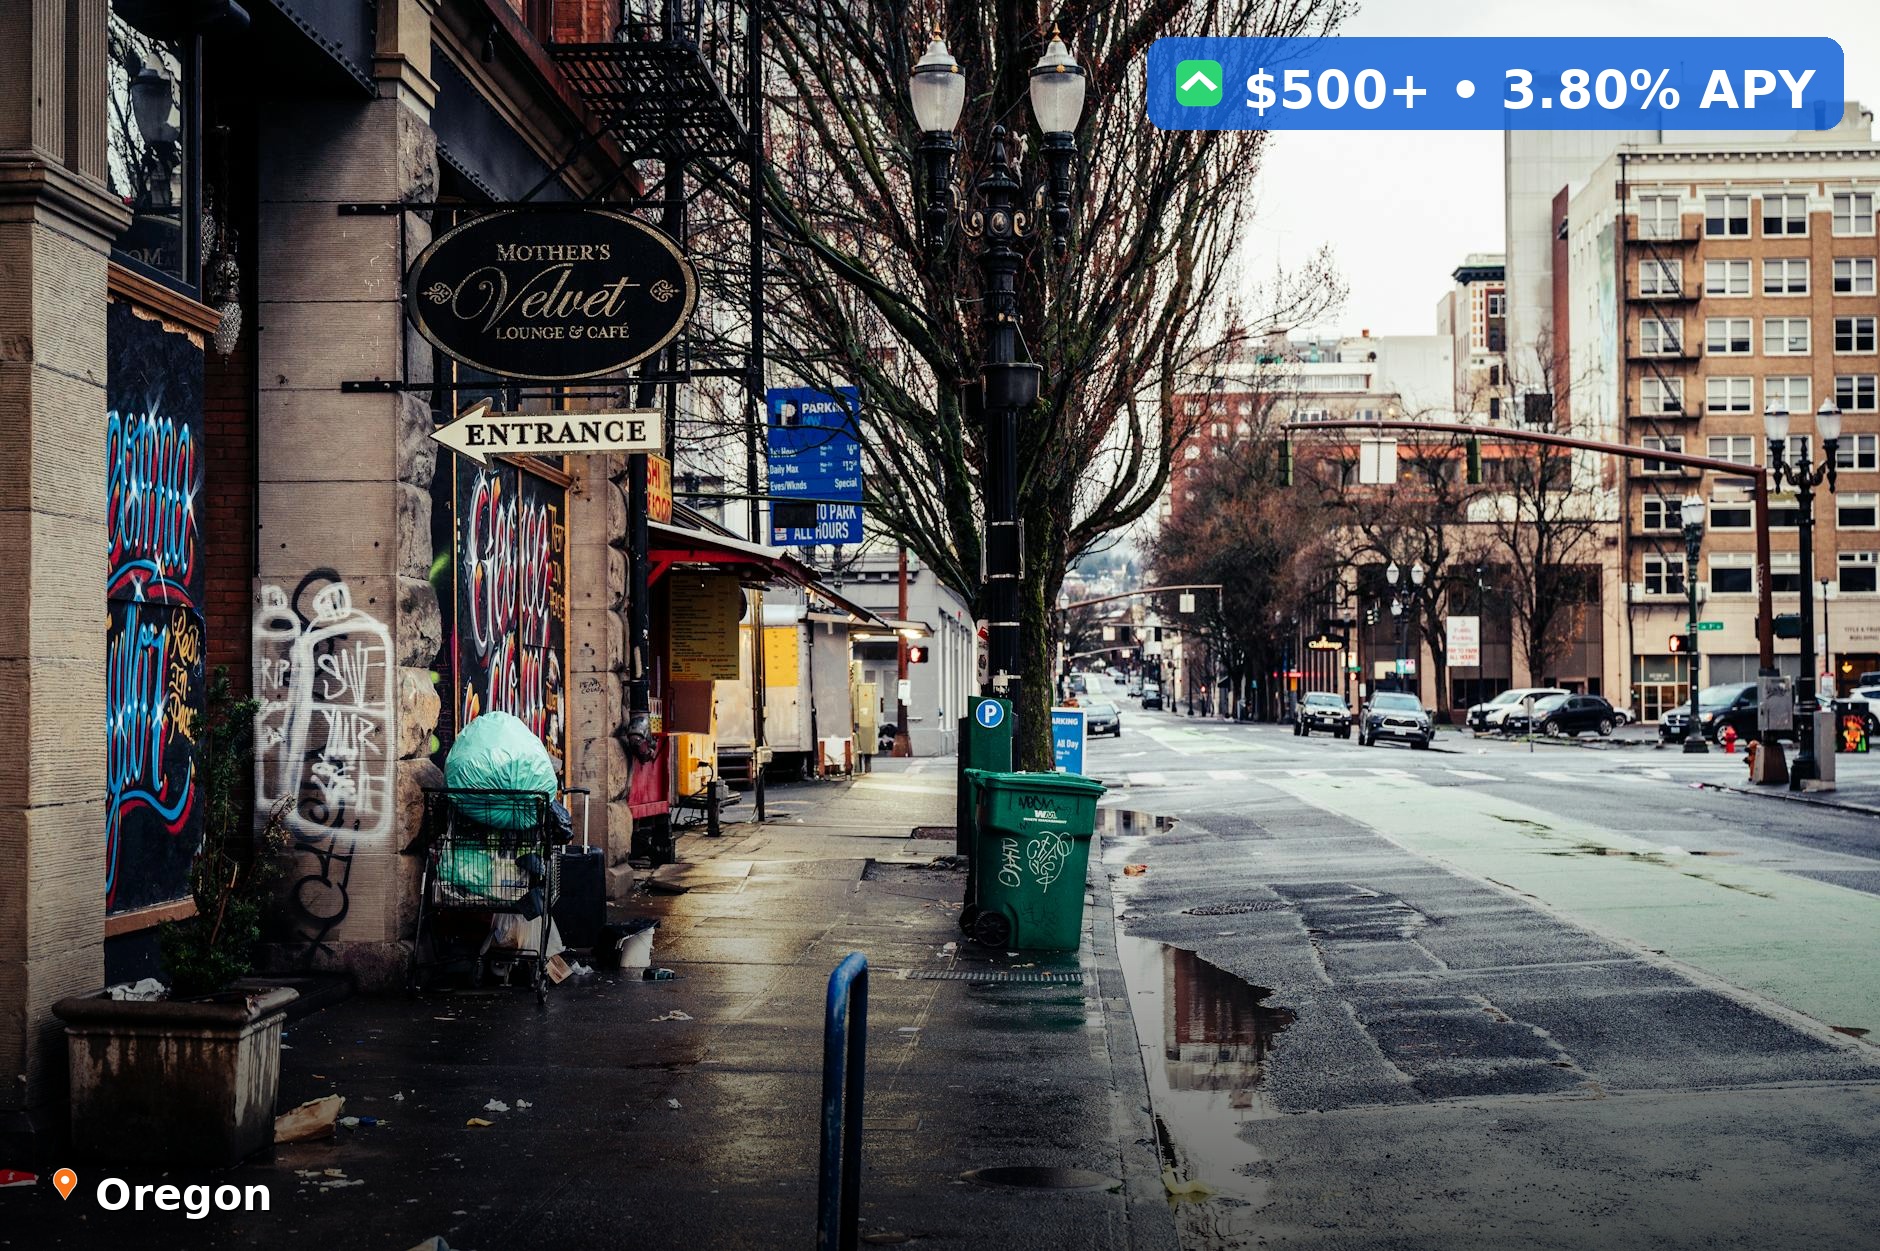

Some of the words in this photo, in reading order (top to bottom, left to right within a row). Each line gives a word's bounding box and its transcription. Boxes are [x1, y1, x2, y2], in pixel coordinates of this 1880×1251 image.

[496, 243, 611, 262] MOTHER'S
[451, 262, 641, 334] Velvet
[496, 326, 565, 340] LOUNGE
[568, 325, 584, 339] &
[587, 322, 630, 339] CAFÉ
[464, 420, 647, 446] ENTRANCE
[769, 464, 785, 476] Daily
[786, 463, 799, 474] Max
[834, 477, 858, 489] Special
[829, 503, 857, 520] PARK
[815, 521, 849, 540] HOURS
